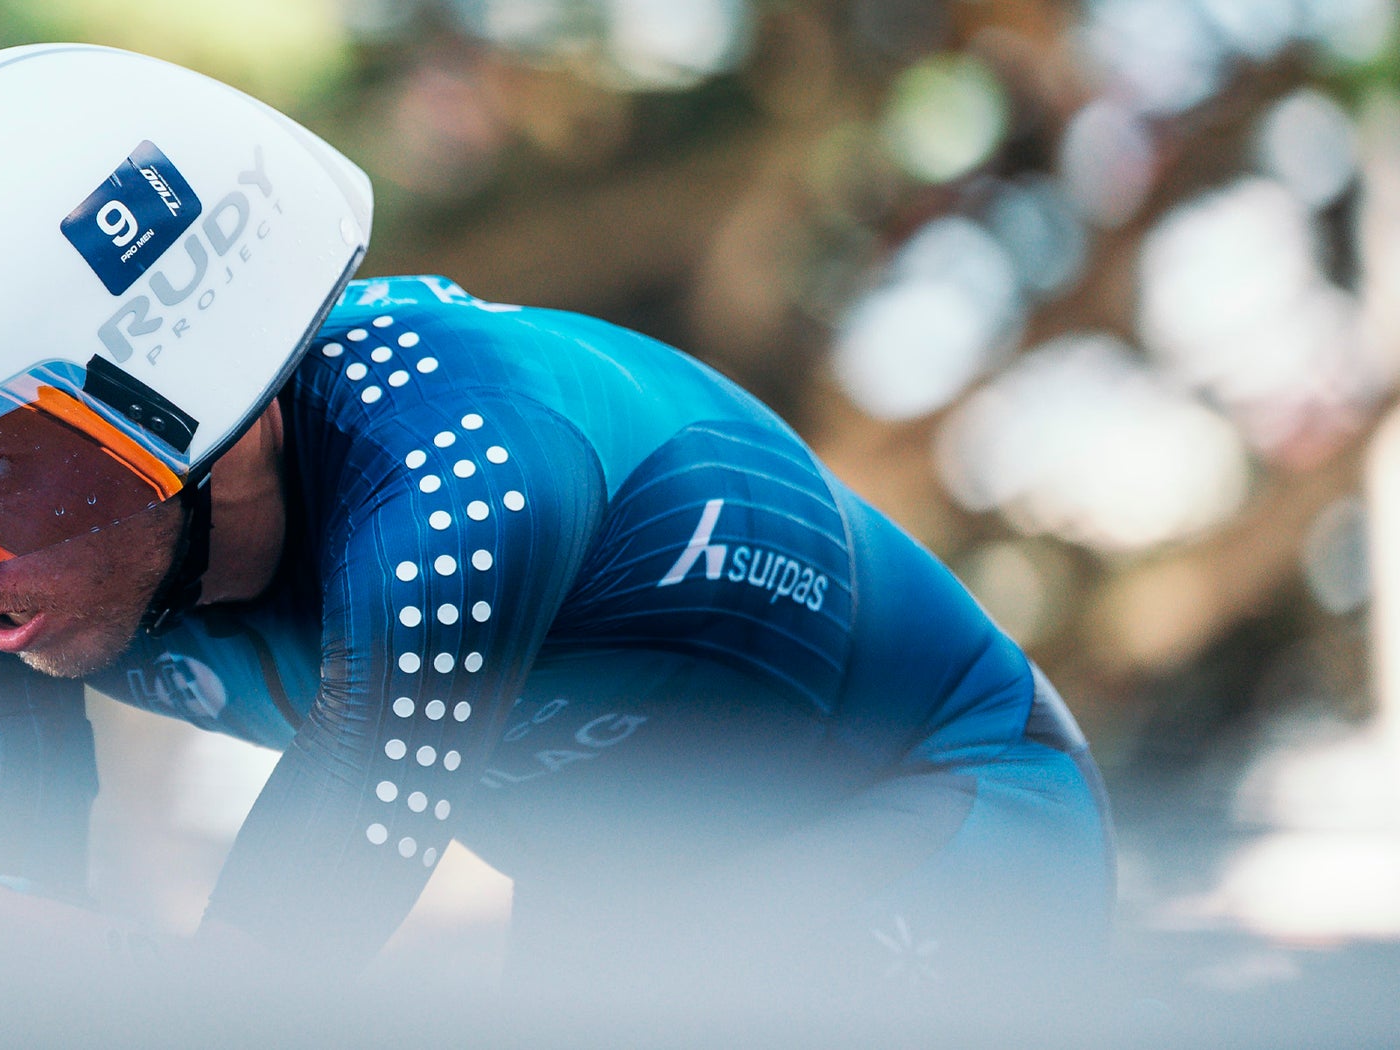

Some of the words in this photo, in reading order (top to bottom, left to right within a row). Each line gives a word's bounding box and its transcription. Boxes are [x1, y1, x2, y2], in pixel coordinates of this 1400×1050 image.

[96, 200, 138, 247] 9
[140, 168, 180, 217] T100
[97, 144, 273, 363] RUDY
[120, 245, 138, 263] PRO
[137, 228, 155, 249] MEN
[146, 199, 284, 366] PROJECT
[728, 545, 829, 612] surpas
[480, 713, 649, 789] LAG
